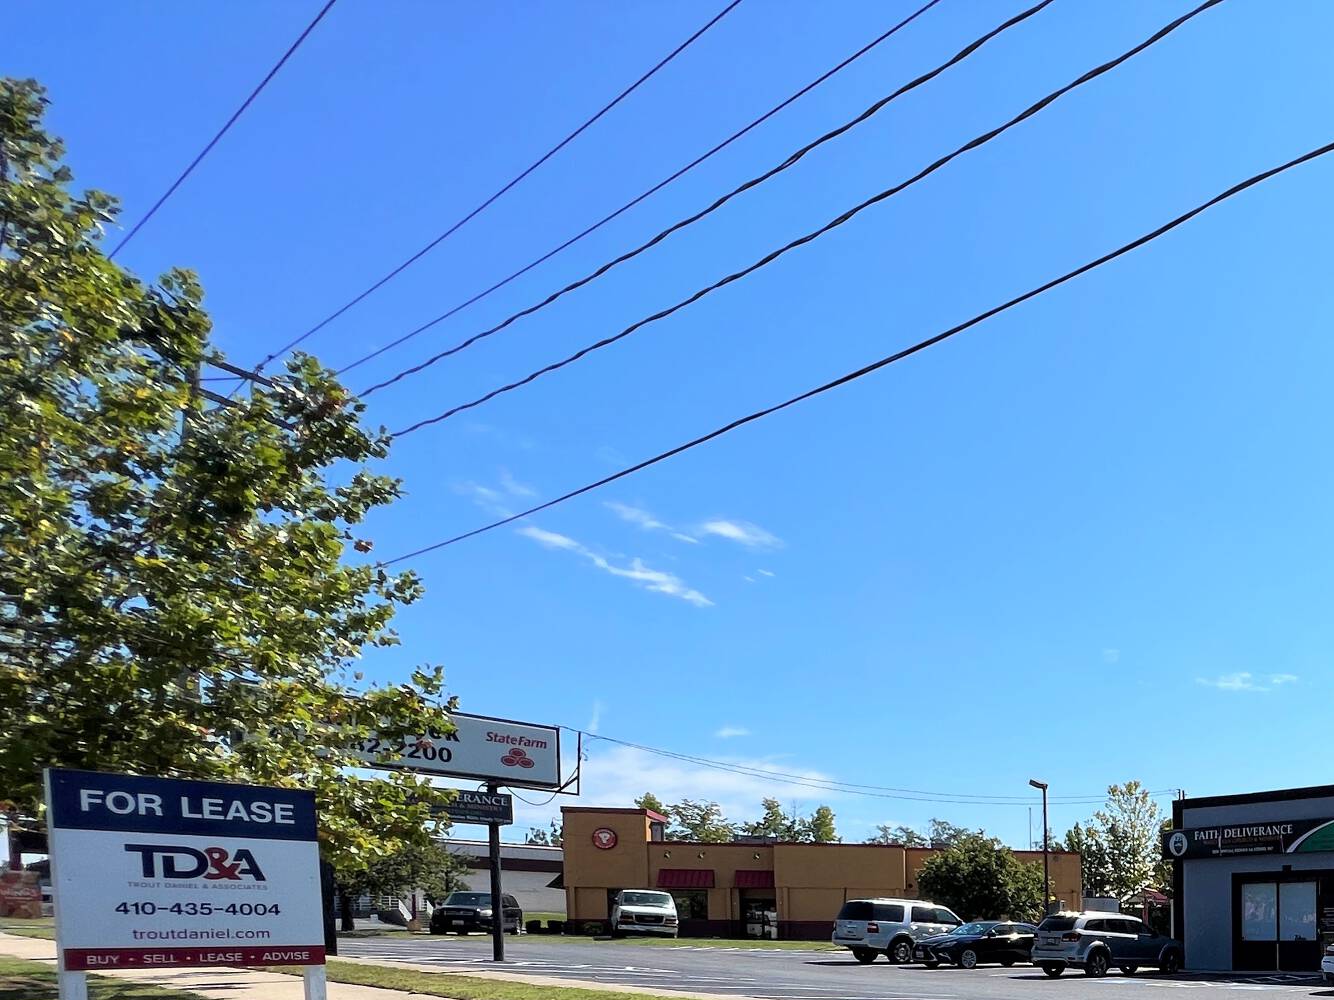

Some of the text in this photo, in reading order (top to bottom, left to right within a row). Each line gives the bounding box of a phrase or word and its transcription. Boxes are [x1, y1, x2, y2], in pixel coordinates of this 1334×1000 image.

[79, 788, 296, 825] FOR LEASE
[1224, 824, 1294, 839] DELIVERANCE
[124, 843, 267, 882] TD&A
[127, 881, 161, 889] TROUT
[164, 882, 200, 890] DANIEL
[211, 883, 269, 892] ASSOCIATES
[114, 901, 281, 917] 410-435-4004
[132, 927, 271, 940] troutdaniel.com
[86, 951, 310, 965] BUY SELL LEASE ADVISE
